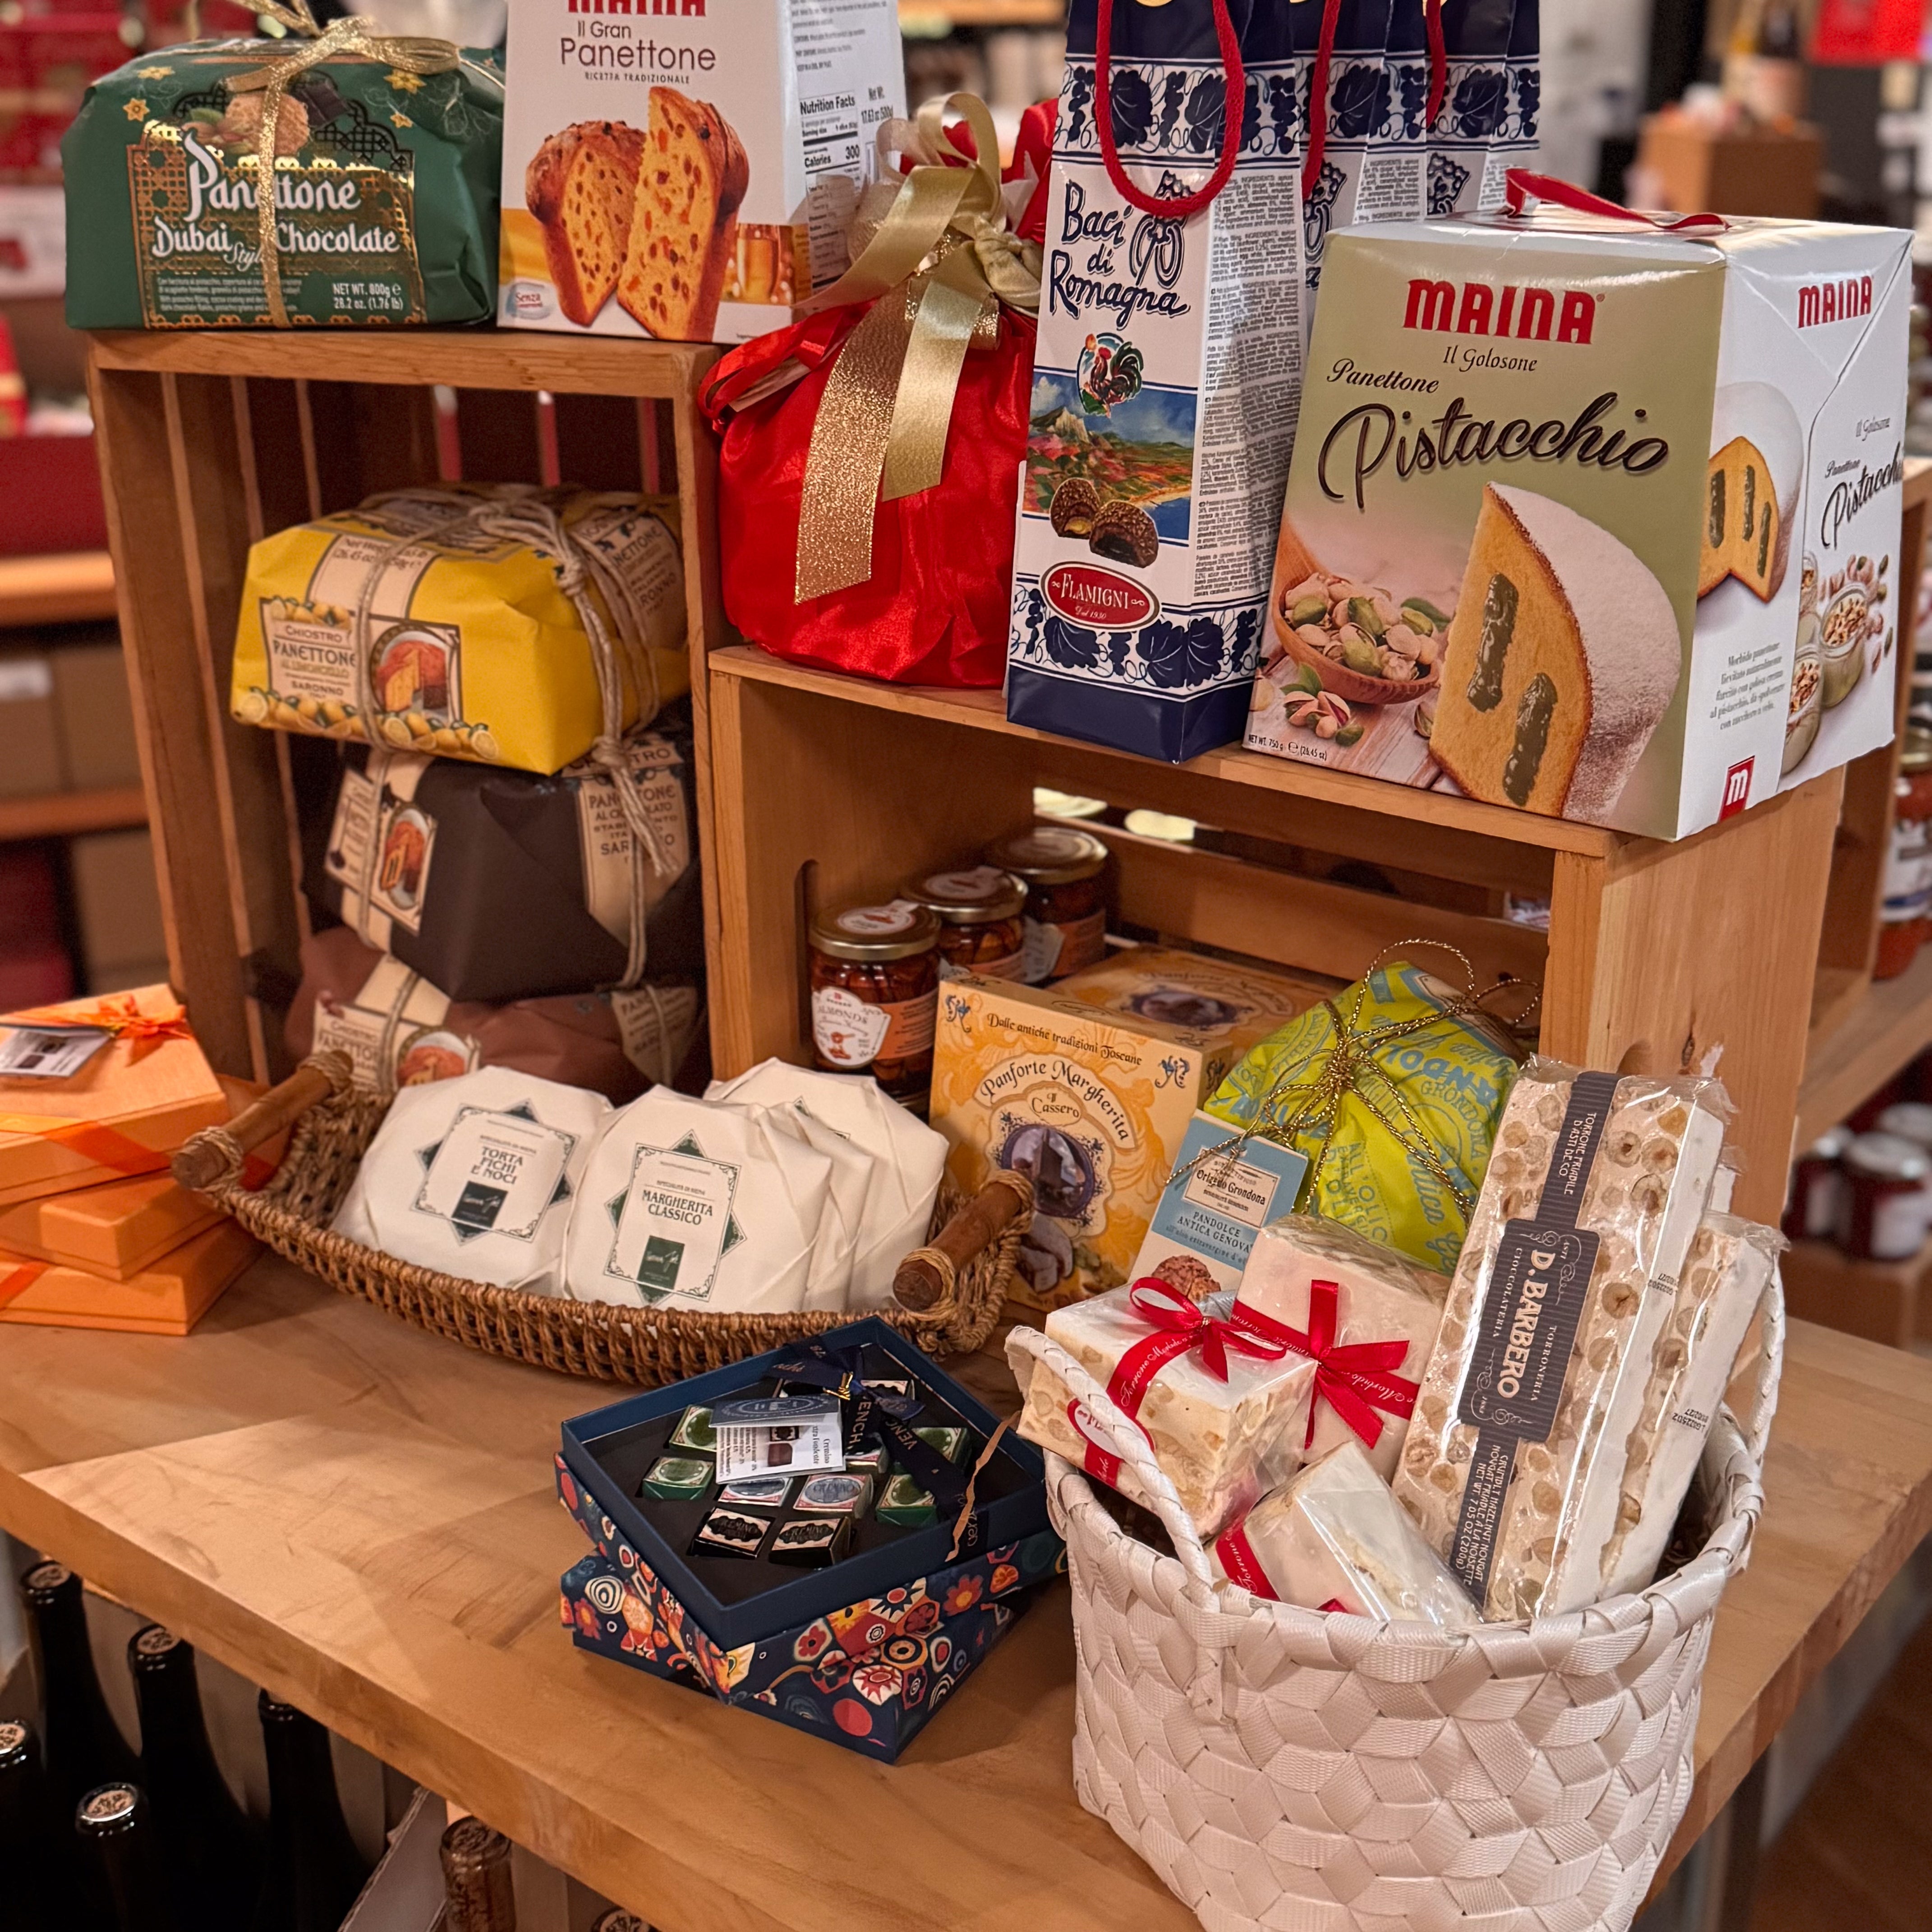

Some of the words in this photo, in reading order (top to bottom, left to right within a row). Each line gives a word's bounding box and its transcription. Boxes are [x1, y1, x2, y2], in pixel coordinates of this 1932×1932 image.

[578, 20, 585, 37] Il
[590, 21, 631, 39] Gran
[561, 37, 716, 71] Panettone
[585, 72, 620, 81] RICETTA
[624, 73, 690, 84] TRADIZIONALE
[800, 98, 834, 114] Nutrition
[836, 95, 856, 109] Facts
[805, 155, 831, 168] Calories
[846, 145, 860, 160] 300
[1061, 179, 1133, 248] Baci
[152, 215, 233, 258] Dubai
[224, 242, 263, 271] Styl
[275, 222, 400, 253] Chocolate
[1086, 244, 1116, 276] di
[332, 283, 349, 294] NET
[351, 283, 368, 295] WT.
[369, 284, 391, 298] 800g
[334, 298, 353, 310] 28.2
[1049, 249, 1191, 331] Romagna
[1798, 275, 1872, 328] MAINA
[1403, 279, 1596, 345] MAINA
[1444, 346, 1458, 364] Il
[1459, 348, 1537, 373] Golosone
[1327, 358, 1440, 394] Panettone
[1318, 392, 1669, 510] Pistacchio
[1825, 459, 1860, 478] Panettone
[1061, 573, 1128, 609] FLAMIGNI
[286, 625, 343, 643] CHIOSTRO
[273, 639, 356, 668] PANETTONE
[292, 681, 344, 696] SARONNO
[987, 1013, 1016, 1030] Dalle
[1017, 1022, 1050, 1040] antiche
[1052, 1030, 1099, 1054] tradizioni
[1100, 1044, 1142, 1067] Toscane
[980, 1060, 1047, 1097] Panforte
[1052, 1060, 1129, 1141] Margherita
[1032, 1098, 1080, 1119] Cassero
[1420, 1080, 1488, 1160] GRONDONA
[1576, 1113, 1596, 1155] TORRONE
[480, 1157, 517, 1173] FICHI
[481, 1146, 524, 1166] TORTA
[483, 1169, 517, 1185] NOCI
[642, 1190, 713, 1217] MARGHERITA
[1228, 1182, 1266, 1205] Grondona
[648, 1203, 702, 1226] CLASSICO
[1177, 1216, 1210, 1236] ANTICA
[1193, 1211, 1242, 1237] PANDOLCE
[1560, 1240, 1571, 1260] ASTI
[1493, 1247, 1522, 1338] CIOCCOLATERIA
[1531, 1325, 1557, 1401] TORRONERIA
[1121, 1360, 1150, 1407] Torrone
[1351, 1373, 1406, 1403] Morbido
[1476, 1463, 1485, 1480] NET
[1486, 1445, 1500, 1484] NOUGAT
[1467, 1498, 1477, 1519] 7.05
[1482, 1497, 1499, 1543] HAZELNUT
[1464, 1522, 1472, 1534] OZ
[1473, 1529, 1482, 1539] LA
[1456, 1536, 1470, 1569] (200g)
[1463, 1542, 1479, 1585] NOISETTE
[1474, 1545, 1488, 1582] NOUGAT
